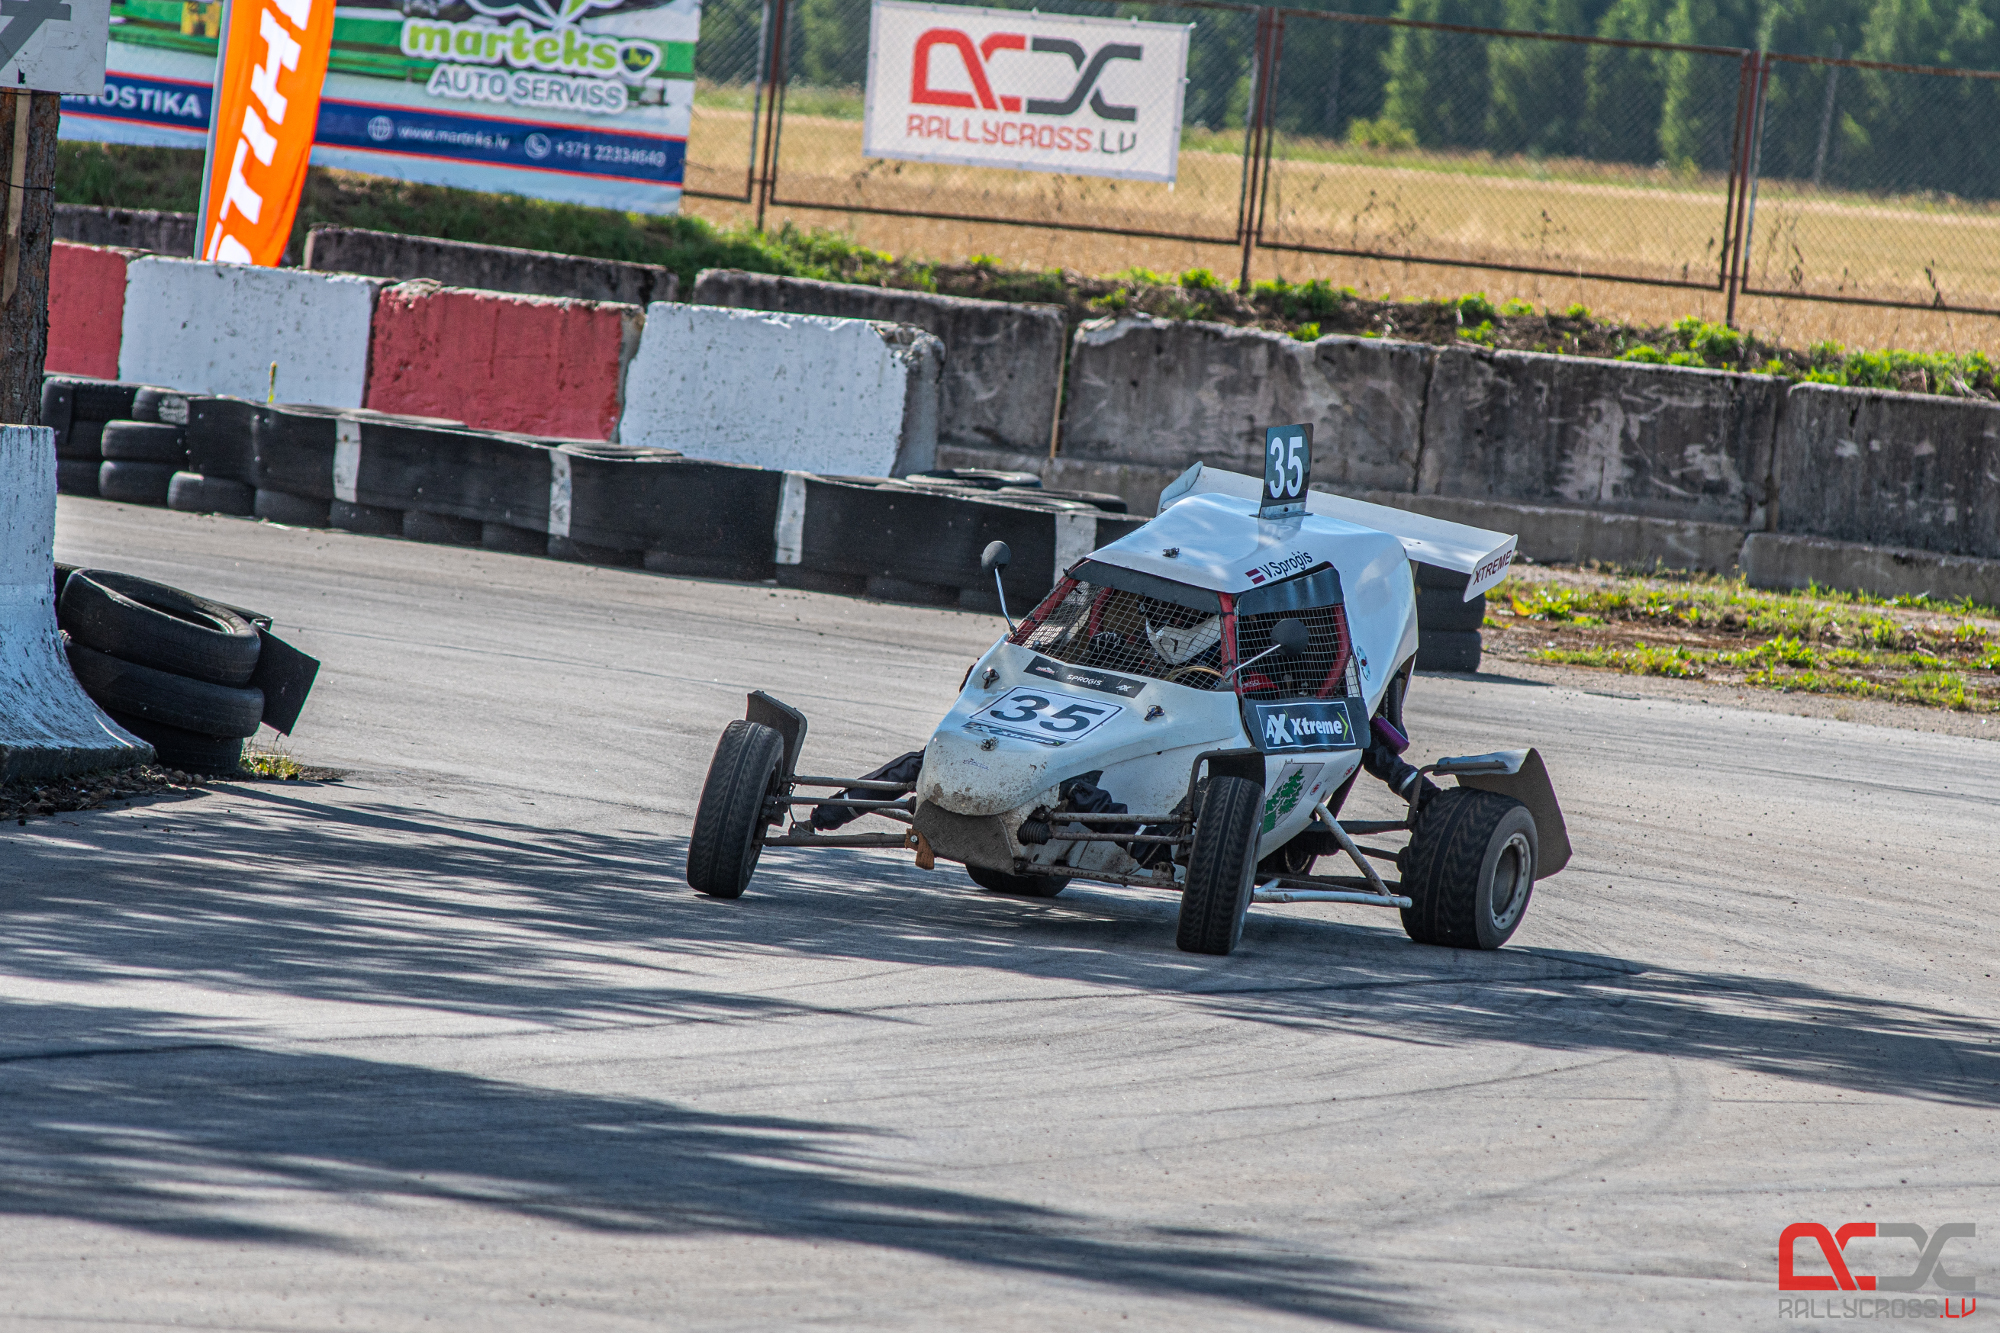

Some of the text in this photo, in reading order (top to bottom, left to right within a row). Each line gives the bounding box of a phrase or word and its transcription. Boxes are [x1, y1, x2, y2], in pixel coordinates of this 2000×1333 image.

[407, 24, 618, 71] marteks
[434, 67, 623, 108] AUTO SERVISS
[398, 126, 510, 151] www.marteks.lv
[907, 114, 1138, 154] RALLYCROSS.LV
[1269, 436, 1304, 498] 35
[1473, 550, 1512, 585] XTREME
[989, 695, 1106, 733] 35
[1266, 713, 1342, 745] AX Xtreme
